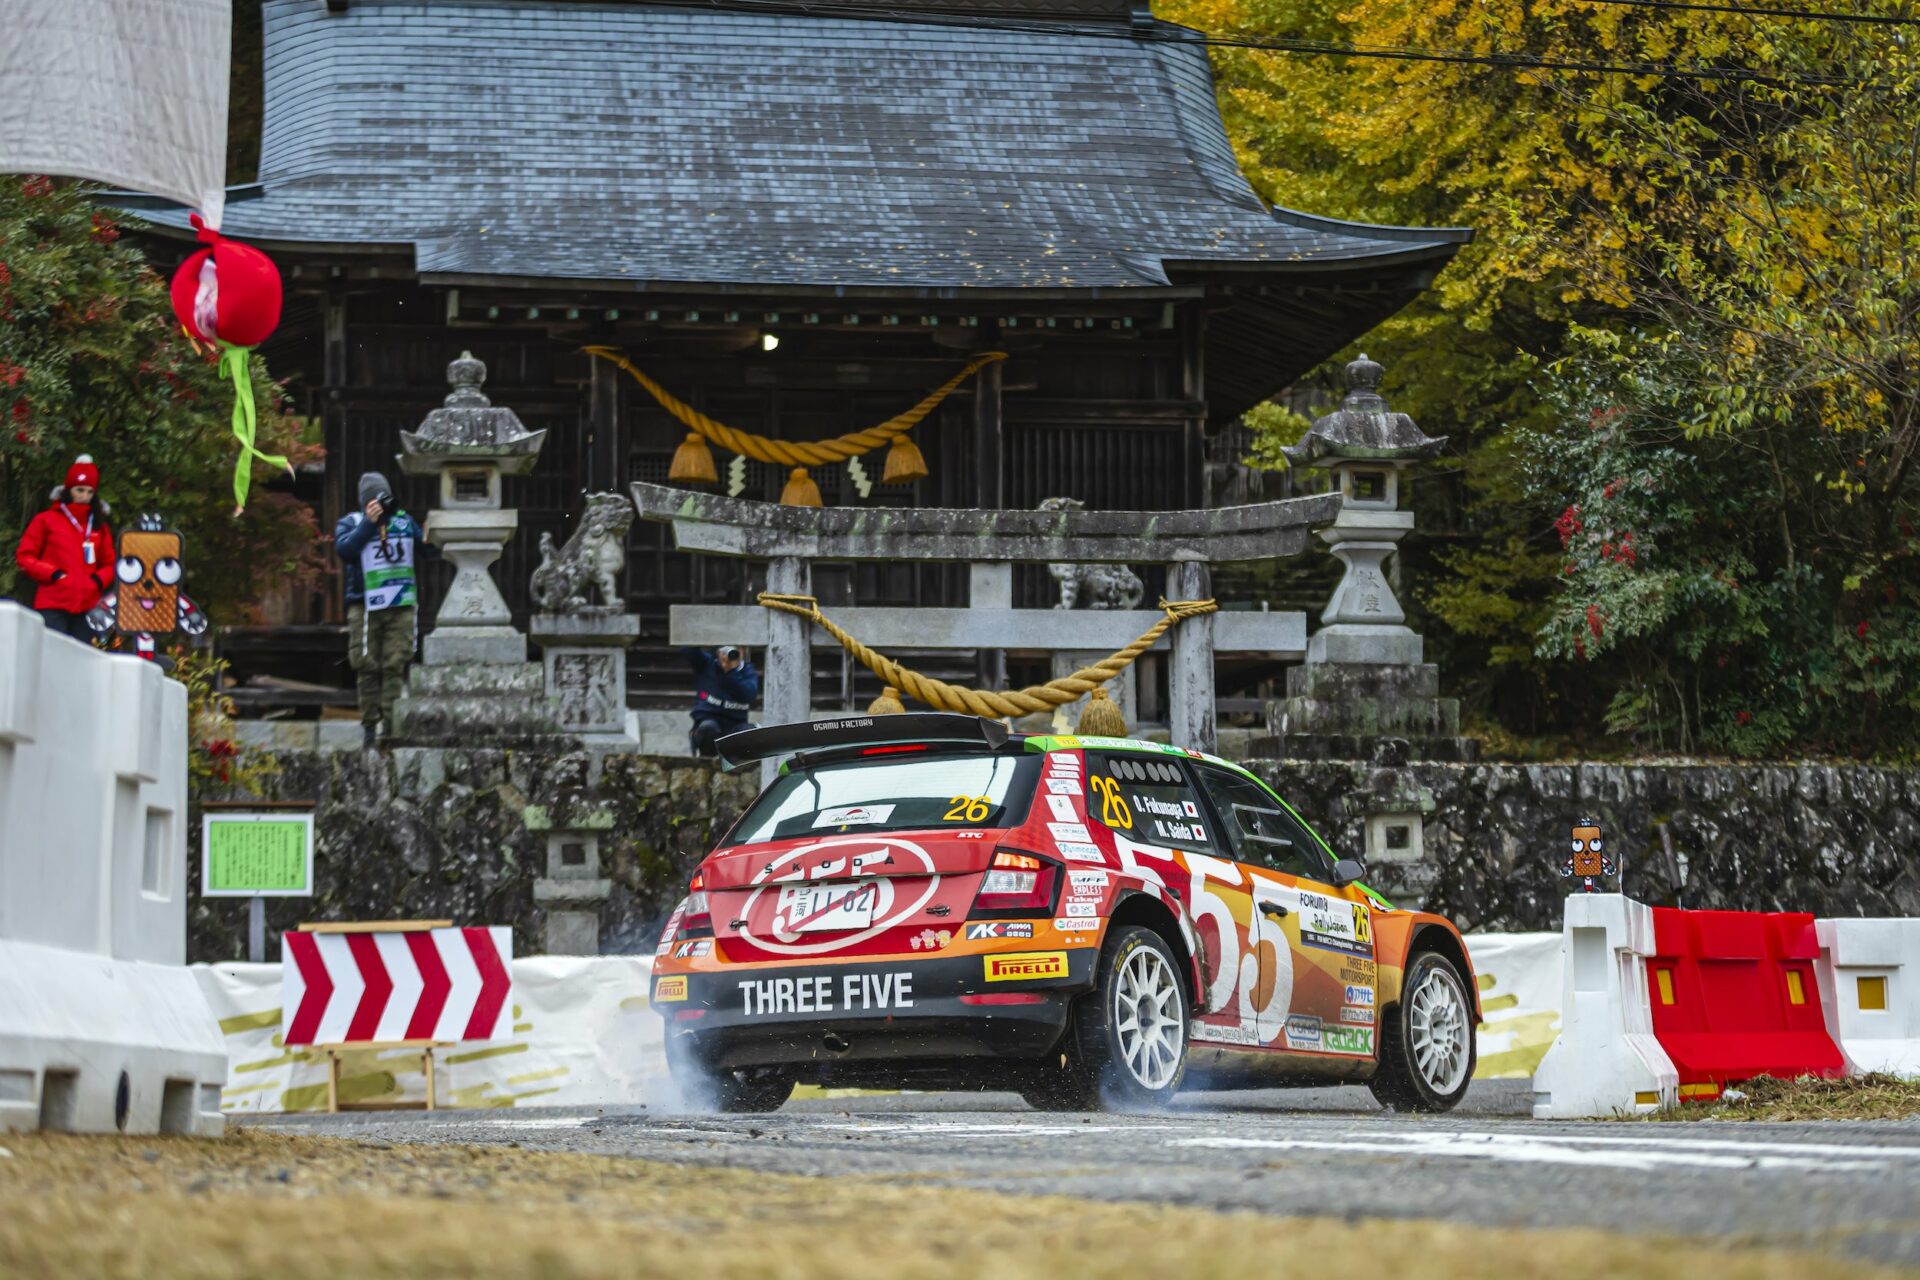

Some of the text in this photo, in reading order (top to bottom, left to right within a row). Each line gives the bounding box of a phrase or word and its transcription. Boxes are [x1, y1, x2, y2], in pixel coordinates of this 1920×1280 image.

[813, 718, 873, 731] OSAMU FACTORY
[943, 795, 992, 822] 26
[1090, 775, 1133, 829] 26
[1143, 796, 1184, 819] Fukunaga
[1154, 820, 1193, 840] M. Saida
[1073, 886, 1102, 894] ENDLESS
[1066, 896, 1103, 904] Takagi
[1300, 893, 1328, 912] FORUM8
[1066, 920, 1096, 928] Castrol
[1352, 905, 1371, 943] 26
[992, 957, 1060, 976] PIRELLI
[1346, 956, 1375, 974] THREE FIVE
[1340, 968, 1375, 986] MOTORSPORT
[658, 981, 684, 996] PIRELLI
[738, 972, 914, 1015] THREE FIVE
